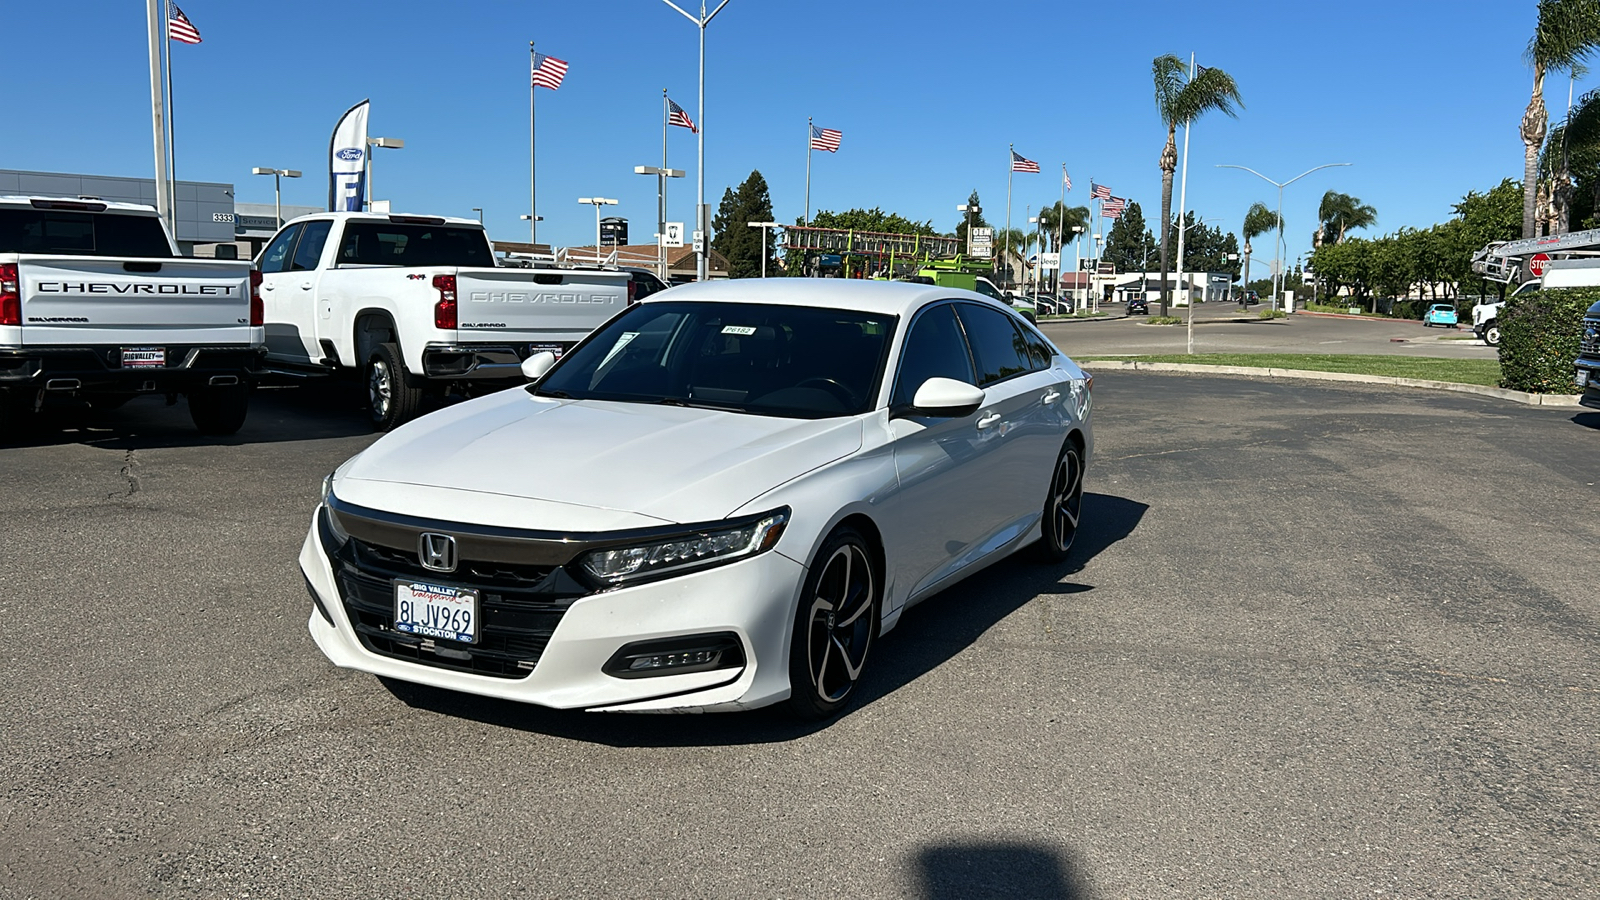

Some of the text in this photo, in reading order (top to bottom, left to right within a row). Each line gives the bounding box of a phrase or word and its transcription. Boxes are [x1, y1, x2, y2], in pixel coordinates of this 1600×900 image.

[341, 148, 362, 160] Ford
[214, 213, 233, 222] 3333
[243, 216, 277, 225] Service
[973, 228, 991, 236] OEM
[1041, 257, 1059, 266] Jeep
[1531, 259, 1545, 269] STO
[38, 282, 237, 295] CHEVROLET
[470, 291, 619, 304] CHEVROLET
[413, 583, 456, 596] BIG VALLEY
[400, 600, 471, 634] 8LJV969
[412, 624, 457, 639] STOCKTON
